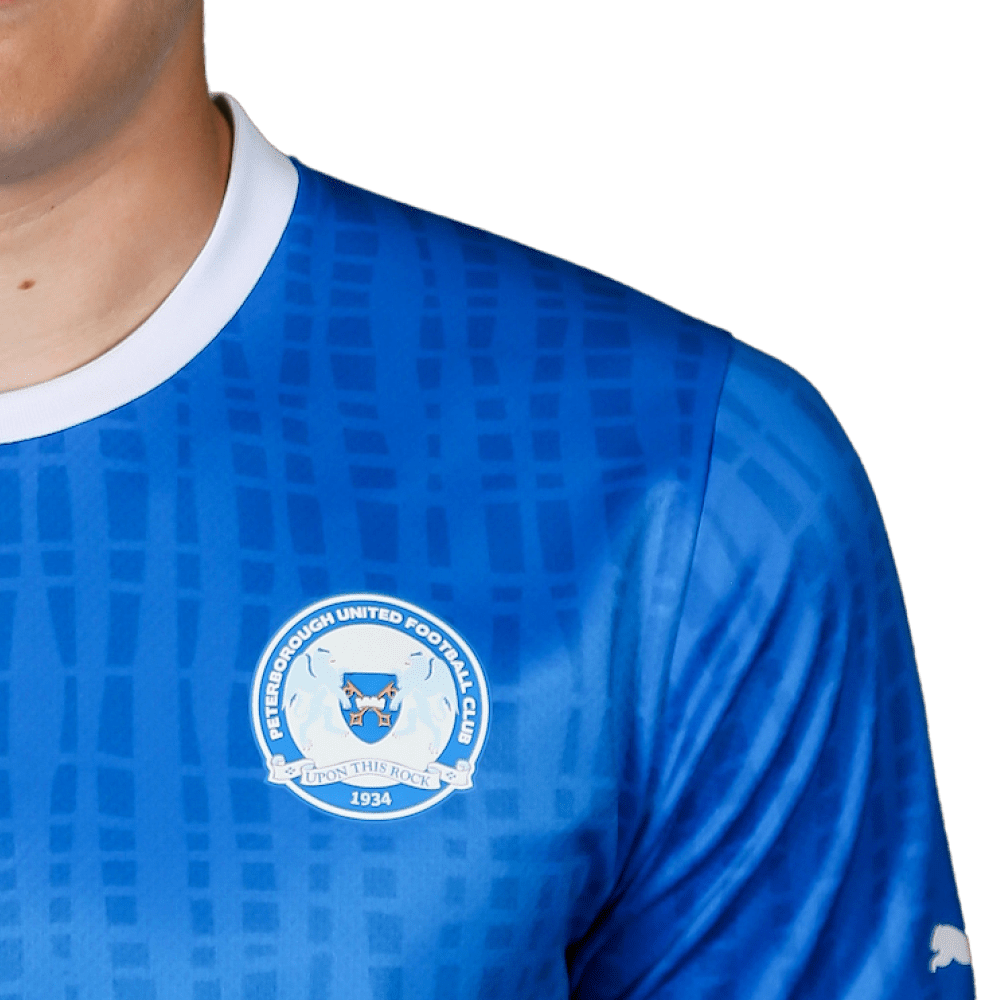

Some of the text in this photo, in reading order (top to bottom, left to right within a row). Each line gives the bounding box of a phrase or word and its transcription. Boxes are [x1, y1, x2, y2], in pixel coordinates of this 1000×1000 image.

[264, 606, 476, 745] PETERBOROUGH UNITED FOOTBALL CLUB
[306, 761, 431, 786] UPON THIS ROCK
[350, 791, 392, 807] 1934
